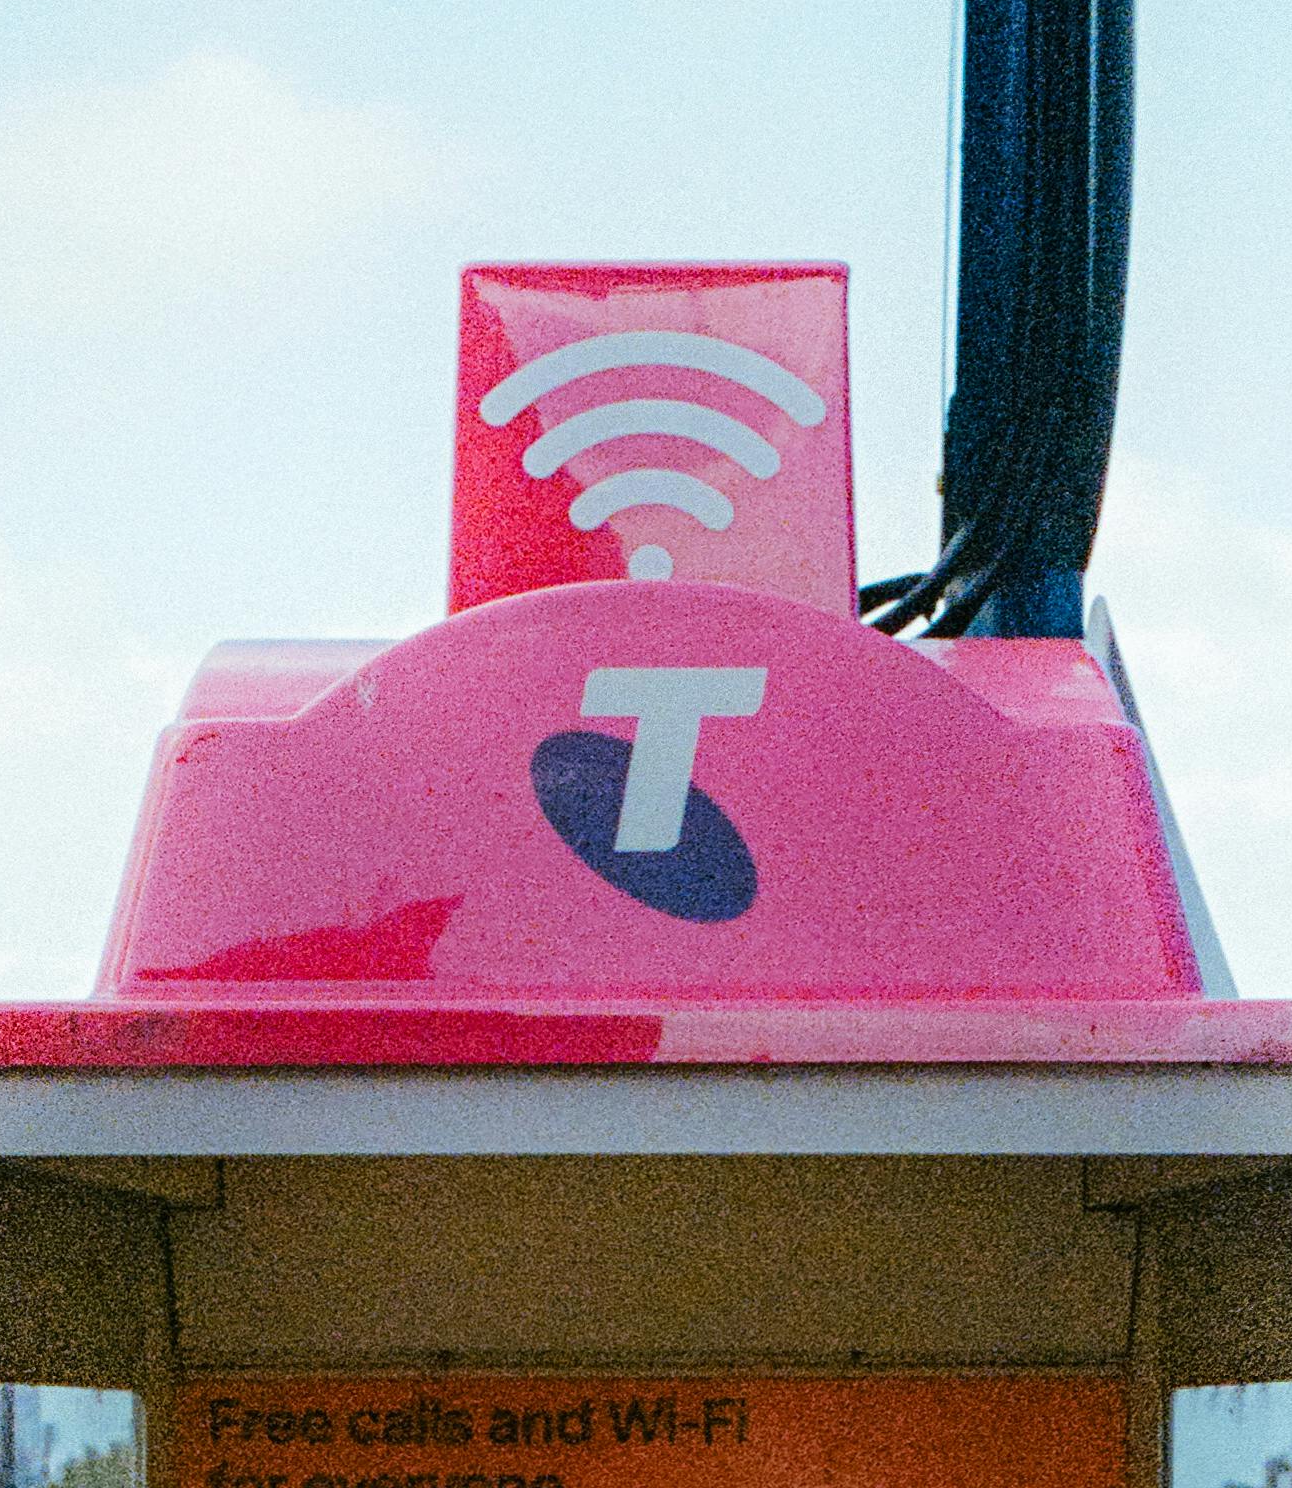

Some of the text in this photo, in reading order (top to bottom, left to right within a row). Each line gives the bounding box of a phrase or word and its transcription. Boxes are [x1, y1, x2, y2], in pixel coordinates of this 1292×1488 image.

[579, 666, 768, 853] T
[208, 1397, 748, 1445] Free calls and Wi-Fi
